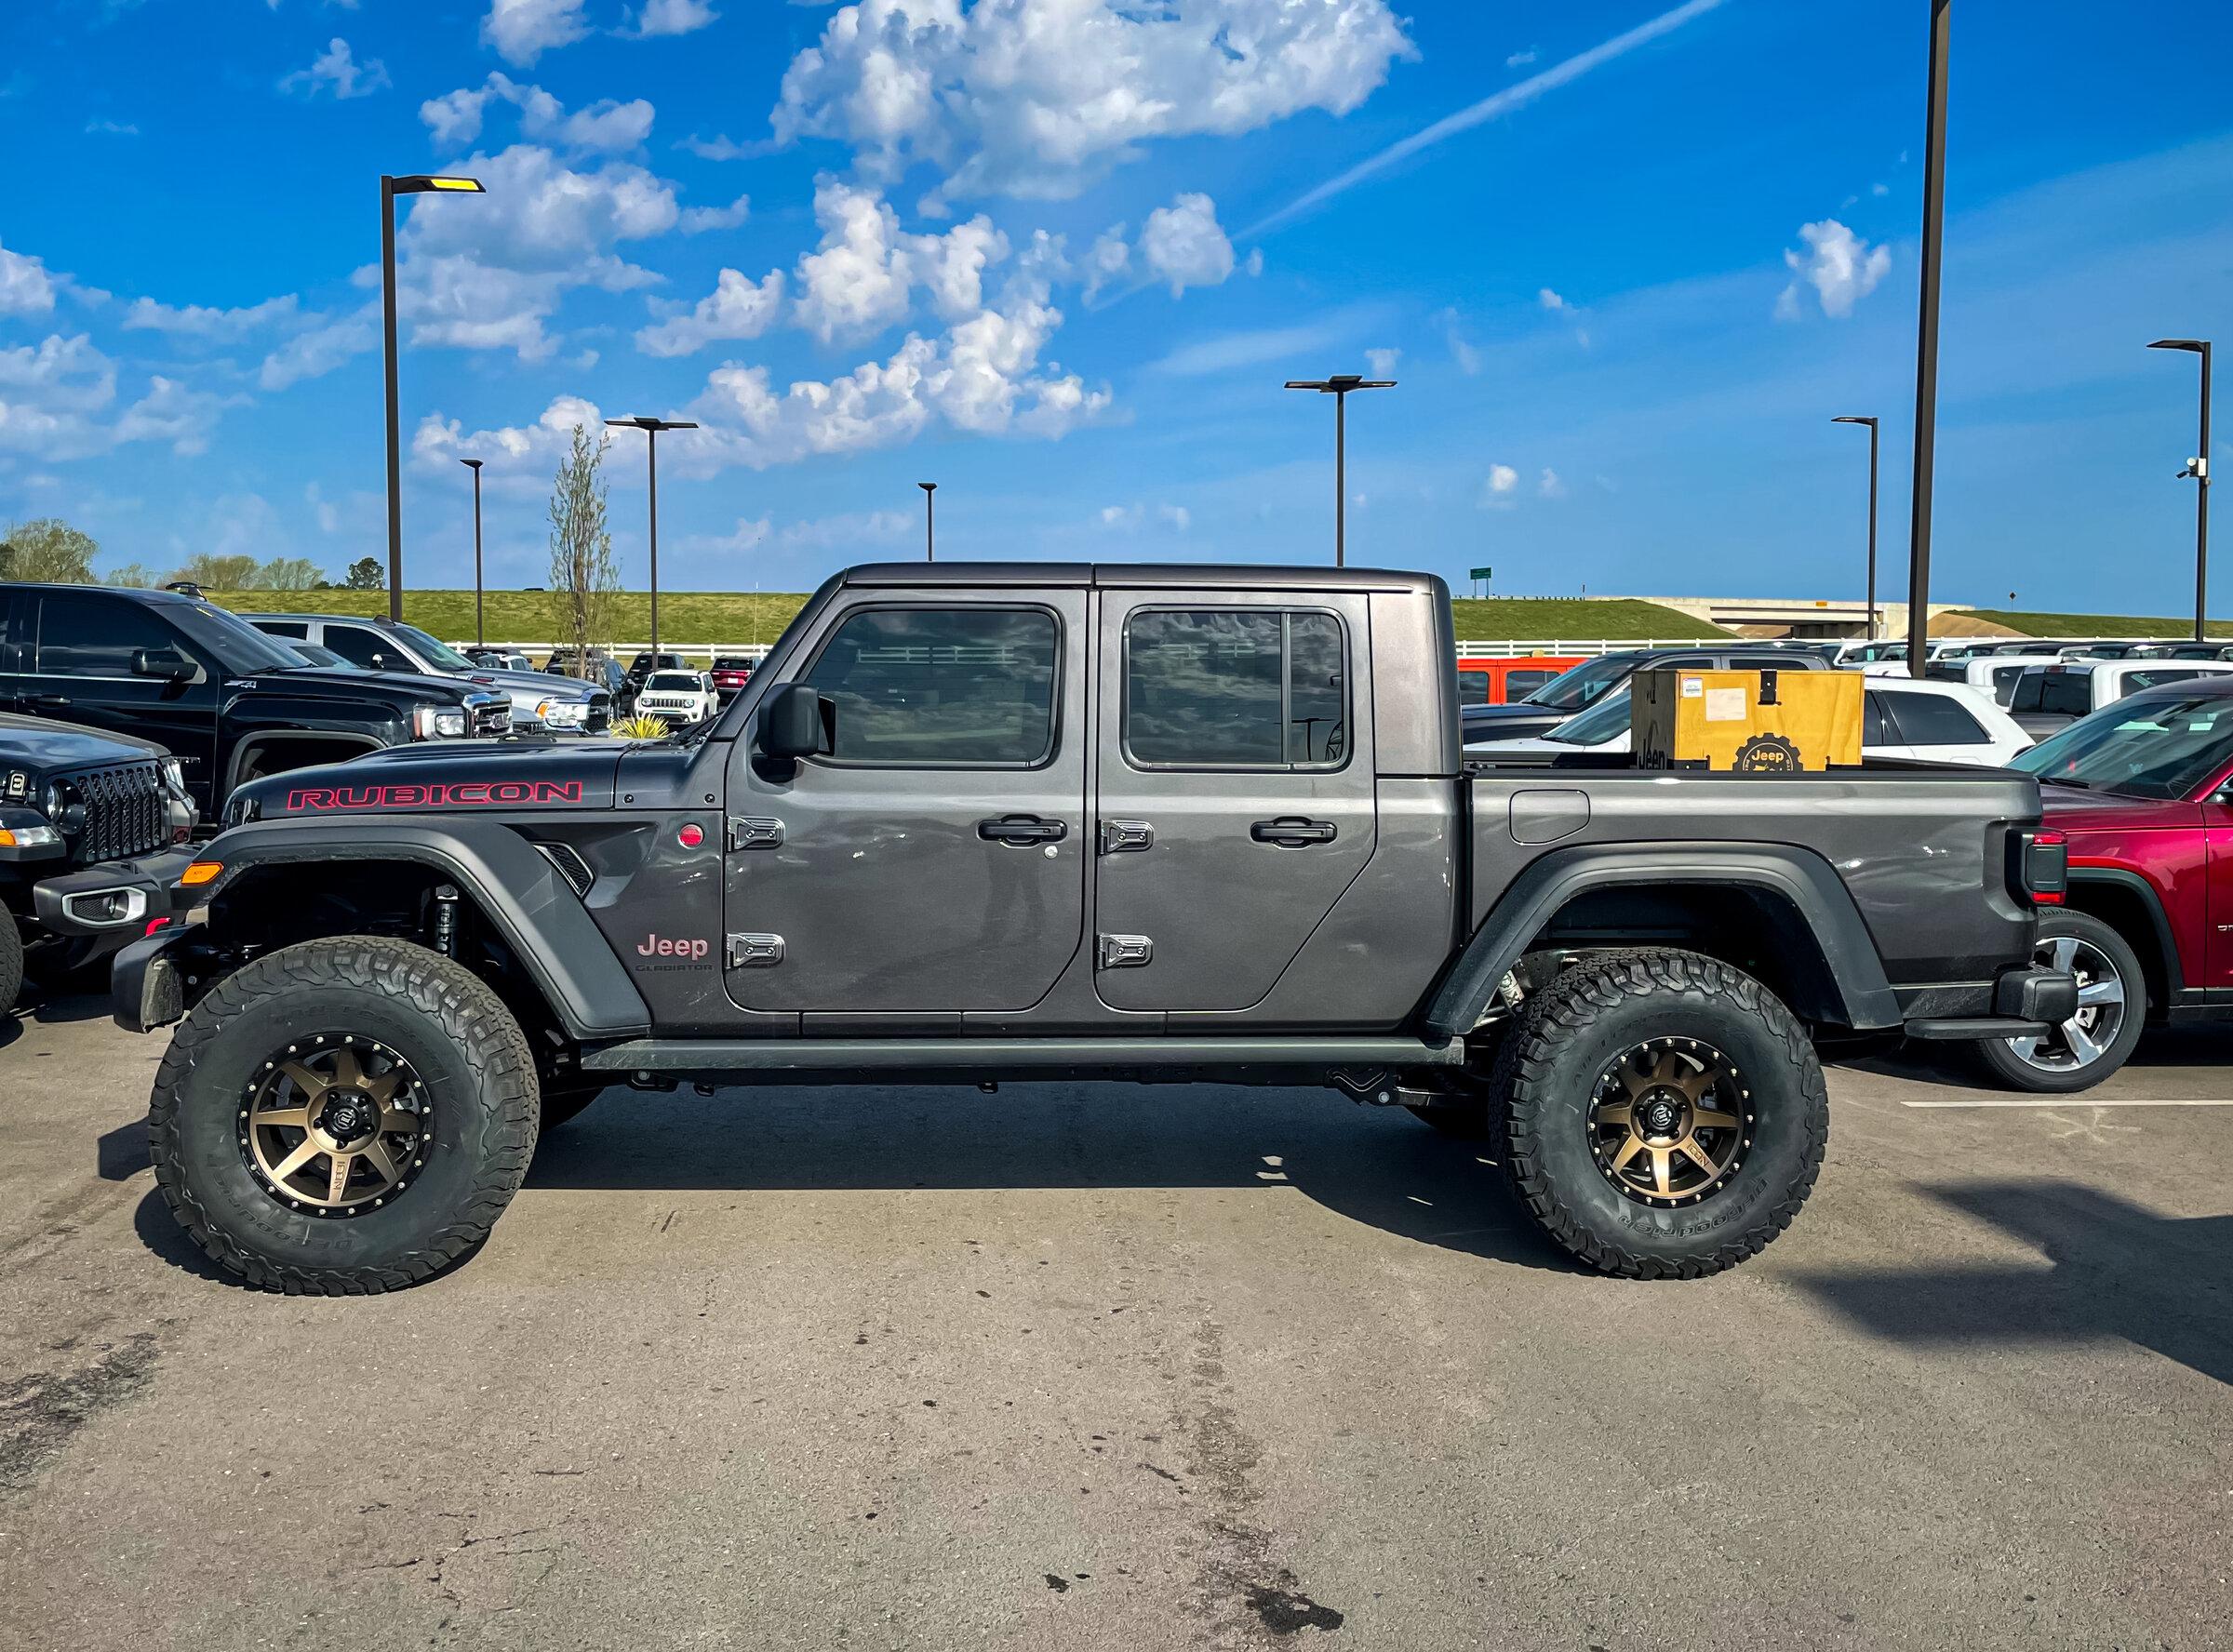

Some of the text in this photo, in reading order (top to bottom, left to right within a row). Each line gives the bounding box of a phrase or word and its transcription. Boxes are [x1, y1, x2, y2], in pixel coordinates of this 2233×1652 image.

[1751, 750, 1785, 763] Jeep
[287, 780, 583, 810] RUBICON
[636, 933, 709, 961] Jeep
[635, 964, 714, 972] GLADIATOR
